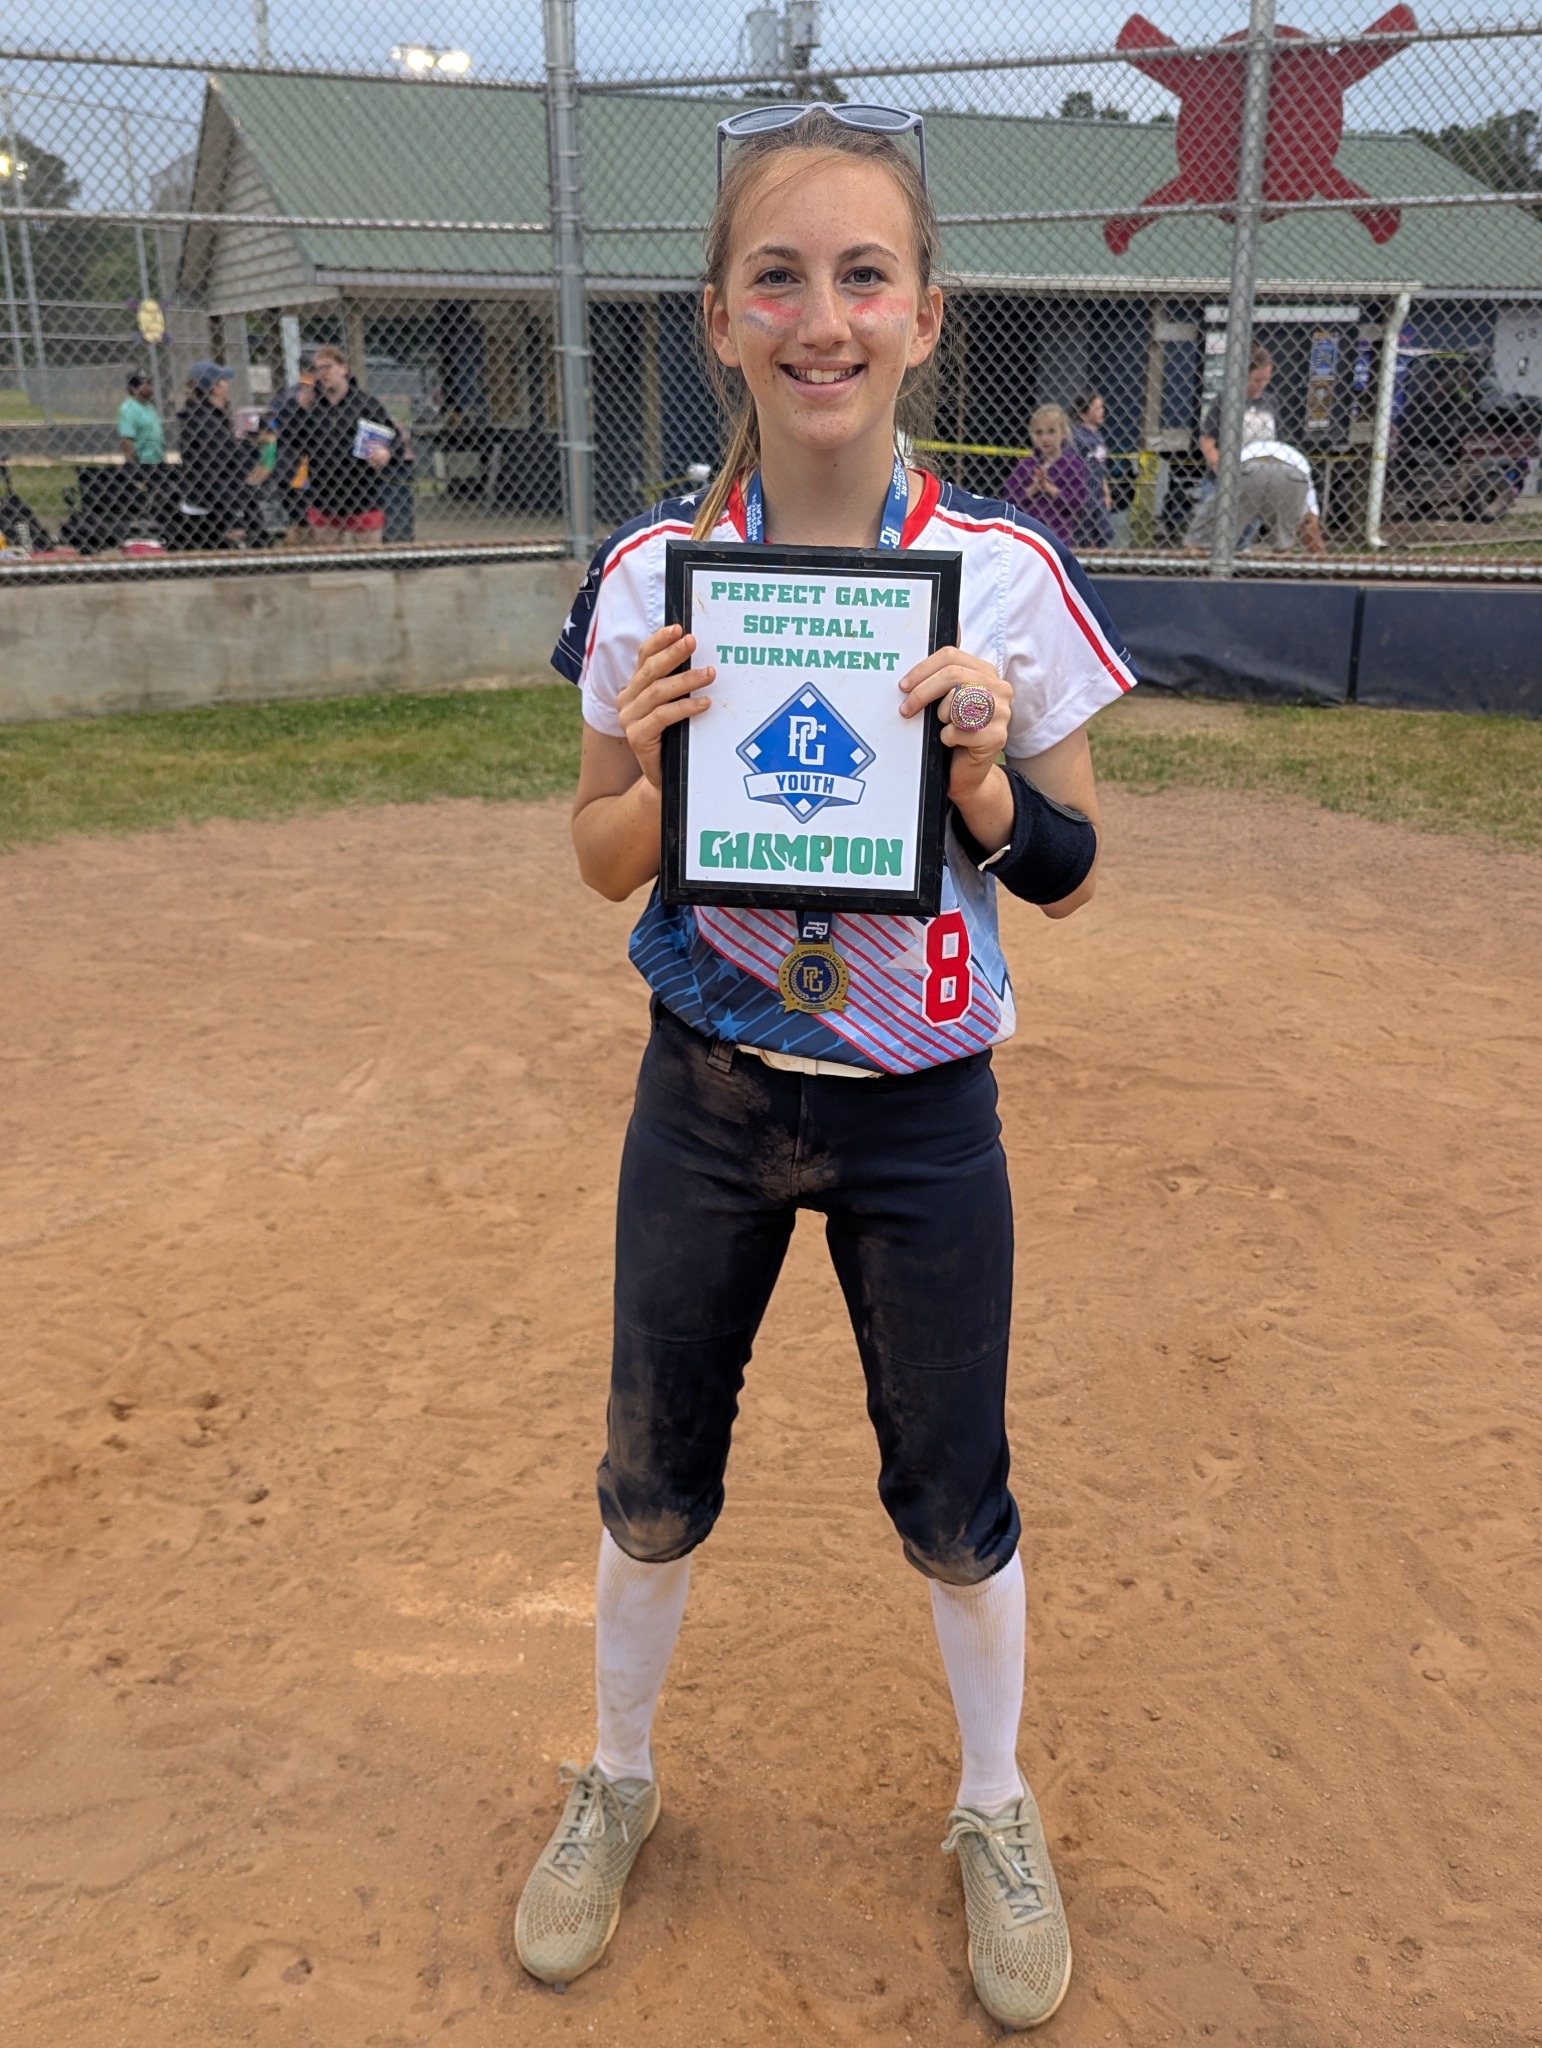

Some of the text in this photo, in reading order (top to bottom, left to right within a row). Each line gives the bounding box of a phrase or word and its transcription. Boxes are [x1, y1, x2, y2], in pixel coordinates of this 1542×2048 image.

[711, 581, 911, 609] PERFECT GAME
[743, 615, 875, 640] SOFTBALL
[716, 645, 900, 672] TOURNAMENT
[787, 715, 827, 767] PG
[775, 774, 835, 795] YOUTH
[699, 830, 903, 877] CHAMPION
[801, 949, 832, 959] PROSPECTS
[831, 957, 842, 969] PLAY
[922, 908, 973, 1027] 8
[802, 966, 824, 992] PG
